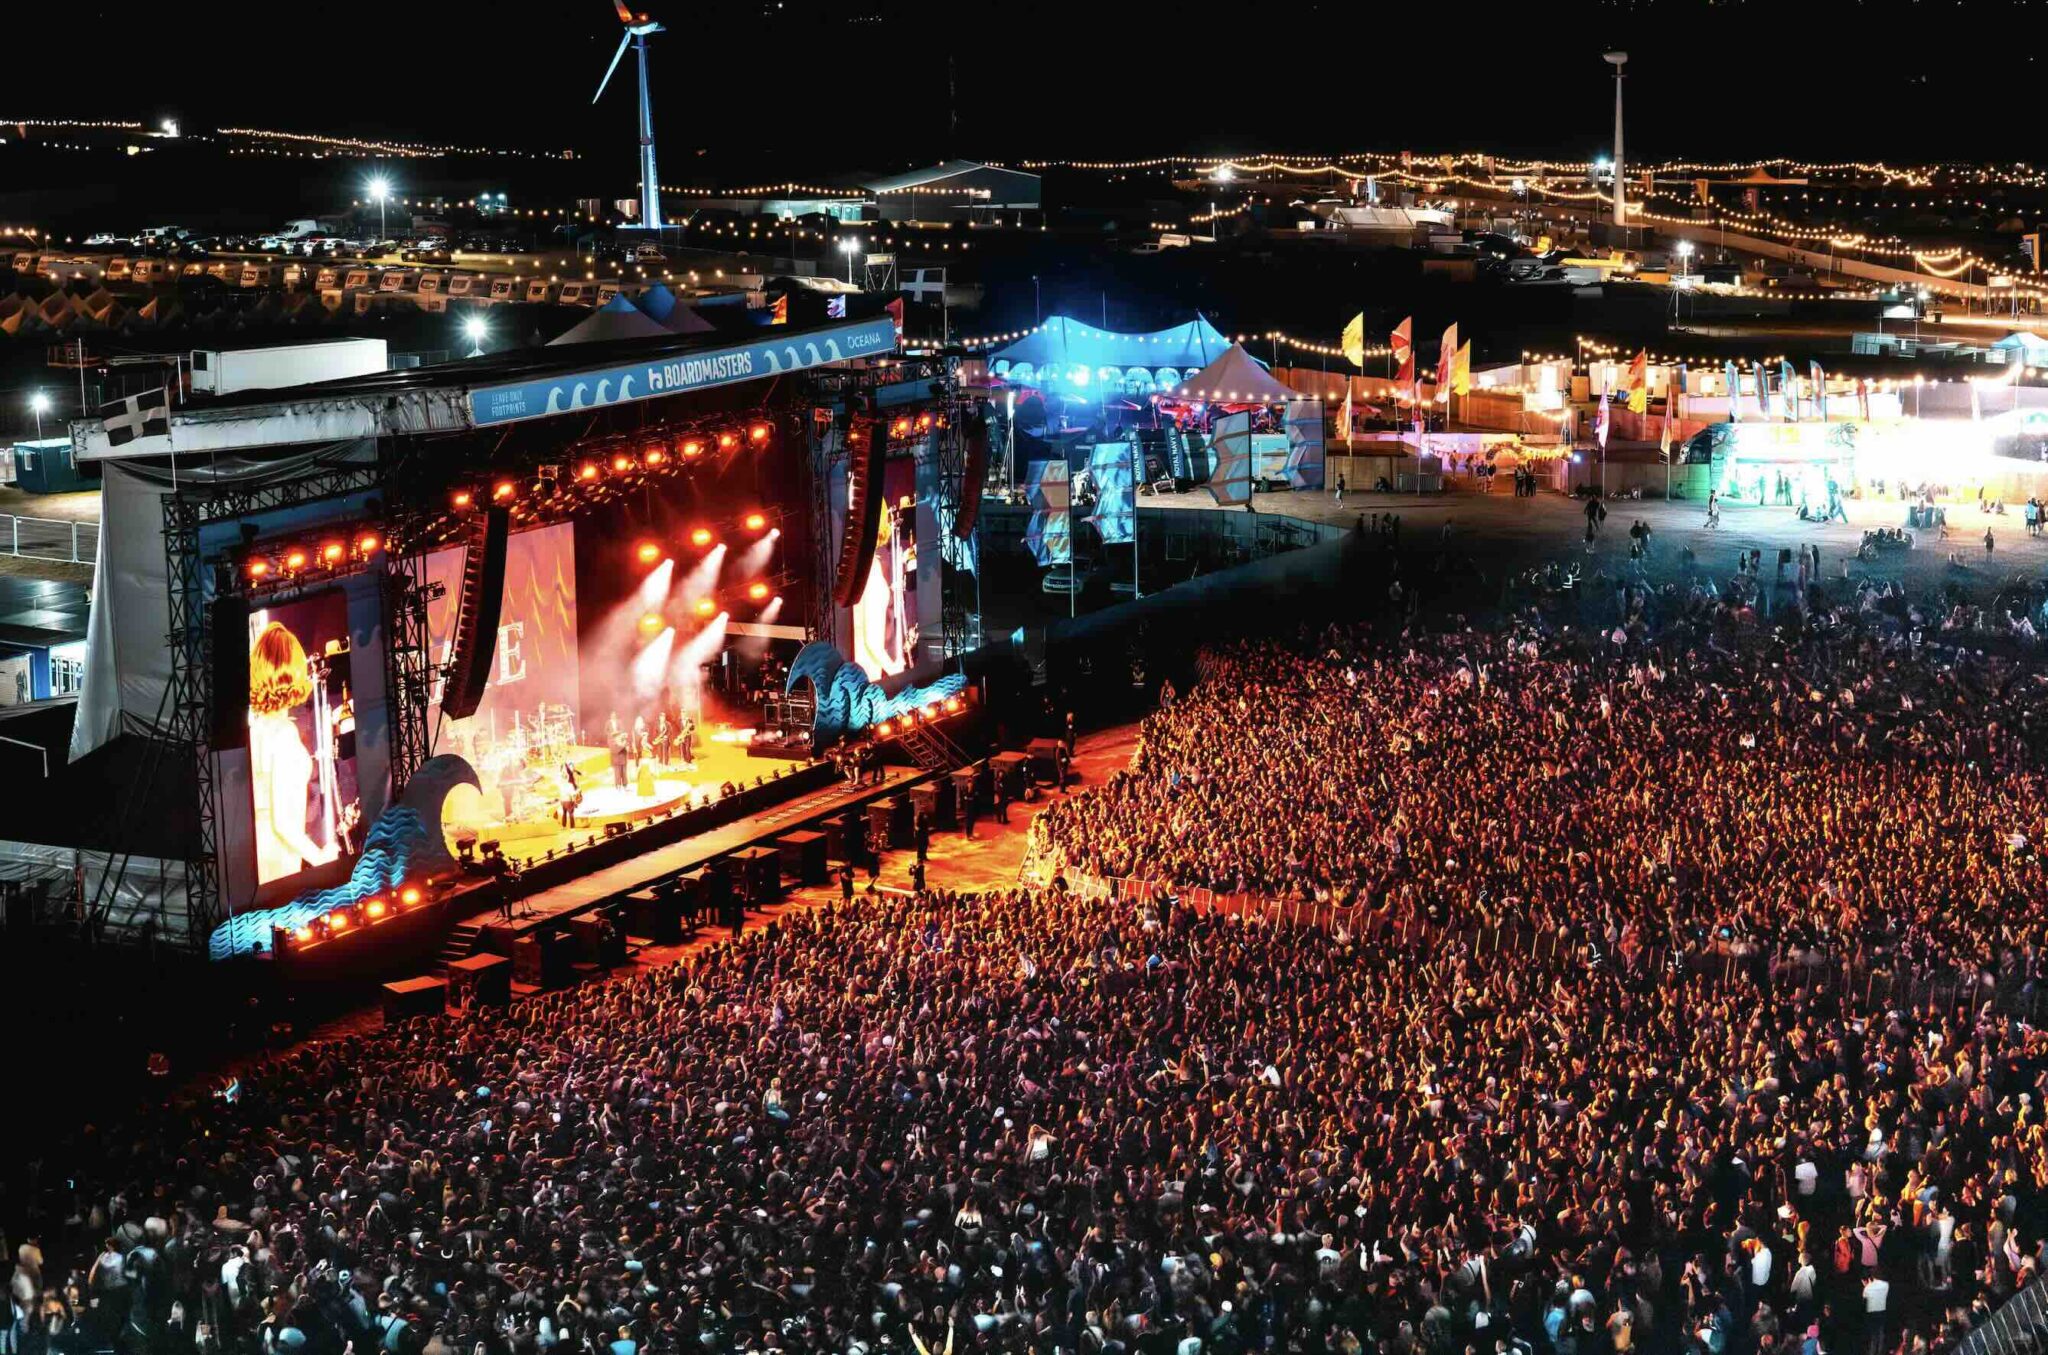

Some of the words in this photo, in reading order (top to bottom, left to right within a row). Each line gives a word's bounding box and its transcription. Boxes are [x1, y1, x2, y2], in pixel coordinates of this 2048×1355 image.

[847, 332, 881, 349] OCEANA
[664, 352, 752, 388] BOARDMASTERS
[1170, 436, 1178, 454] NAVY
[1133, 459, 1141, 480] ROYAL
